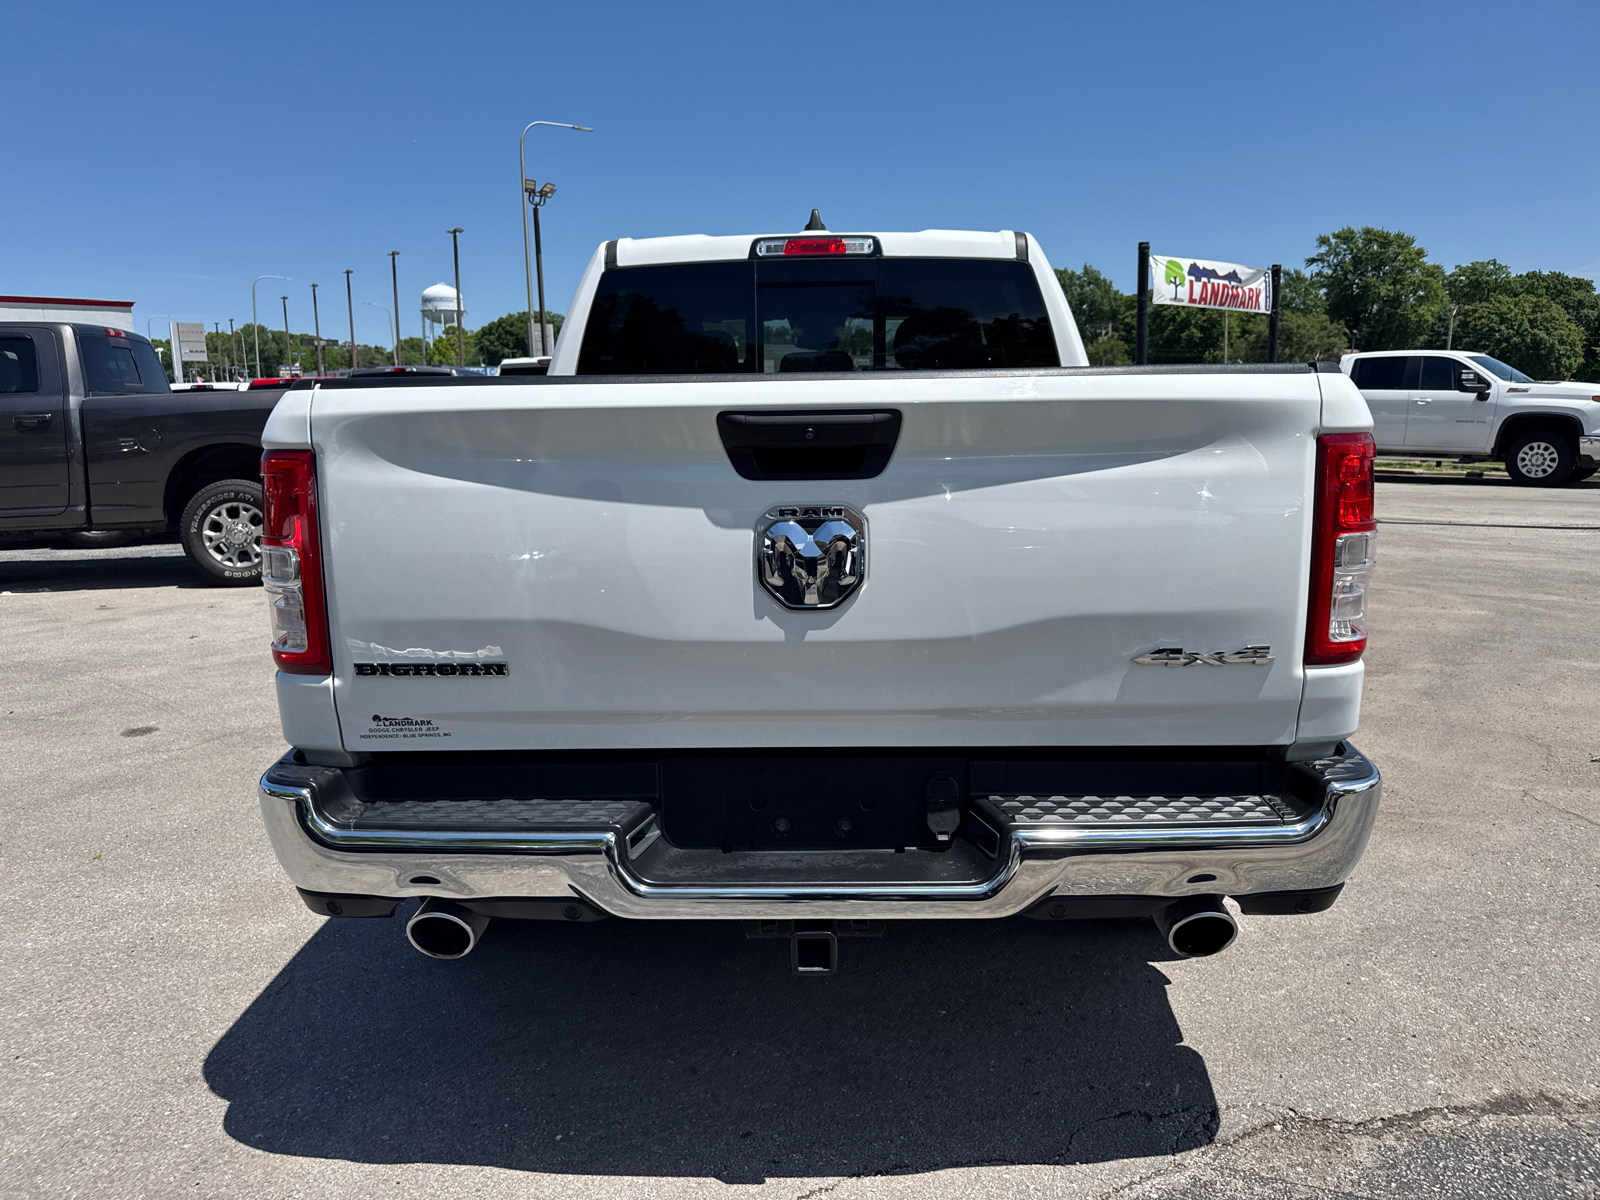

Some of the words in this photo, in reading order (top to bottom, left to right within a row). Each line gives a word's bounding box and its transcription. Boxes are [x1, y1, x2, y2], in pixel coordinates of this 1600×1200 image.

[1188, 280, 1261, 310] LANDMARK
[191, 492, 235, 533] TRANSFORCE
[778, 507, 844, 518] RAM
[353, 662, 509, 677] BIGHORN
